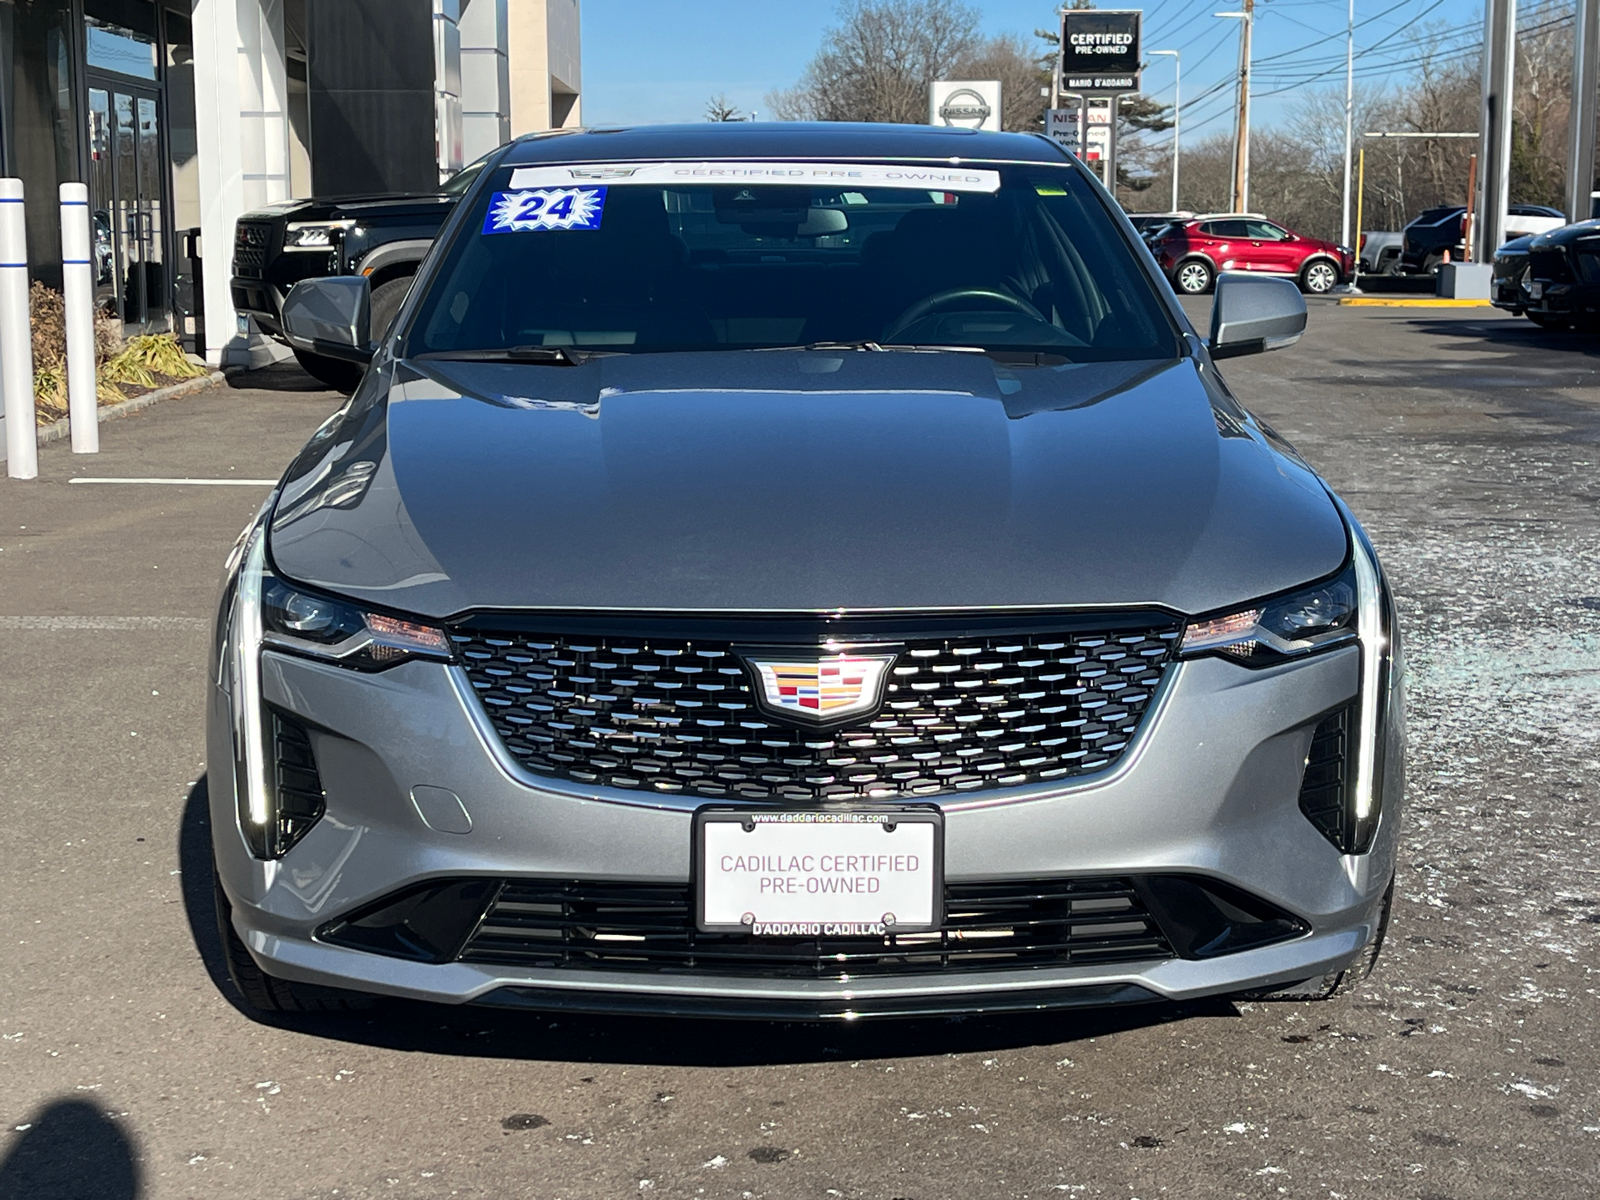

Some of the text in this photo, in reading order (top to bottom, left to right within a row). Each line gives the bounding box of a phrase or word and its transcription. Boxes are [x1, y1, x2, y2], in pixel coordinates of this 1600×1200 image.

[1070, 33, 1133, 45] CERTIFIED
[1075, 45, 1127, 54] PRE-OWNED
[1069, 79, 1092, 87] MARIO
[943, 107, 986, 116] NISSAN
[674, 169, 804, 177] CERTIFIED
[512, 194, 576, 222] 24
[751, 813, 888, 823] www.daddariocadillac.com
[720, 855, 919, 872] CADILLAC CERTIFIED
[760, 877, 880, 893] PRE-OWNED
[752, 922, 886, 936] D'ADDARIO CADILLAC
